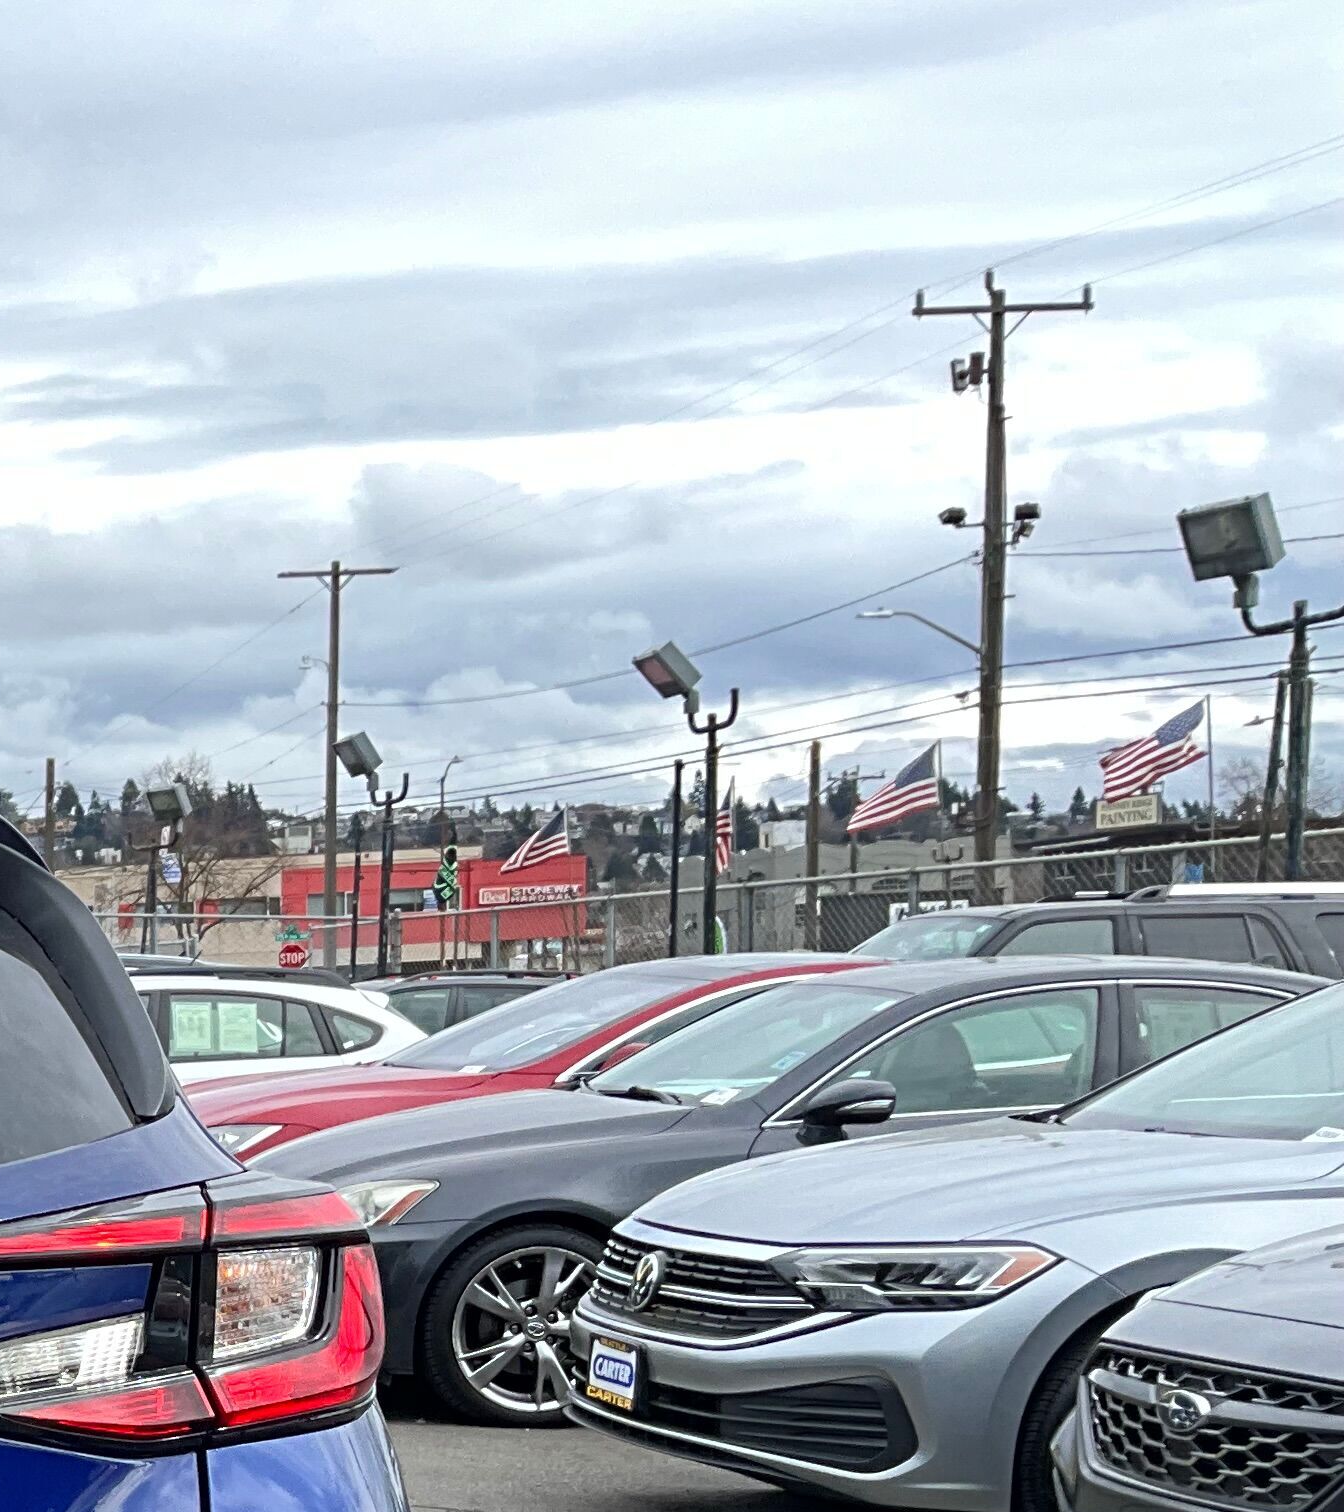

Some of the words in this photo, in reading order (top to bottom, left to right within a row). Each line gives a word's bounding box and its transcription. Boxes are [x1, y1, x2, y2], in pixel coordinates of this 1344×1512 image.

[1100, 807, 1153, 825] PAINTING
[511, 884, 580, 896] STONEWAY
[279, 952, 305, 965] STOP
[594, 1356, 632, 1384] CARTER
[586, 1384, 633, 1410] CARTER
